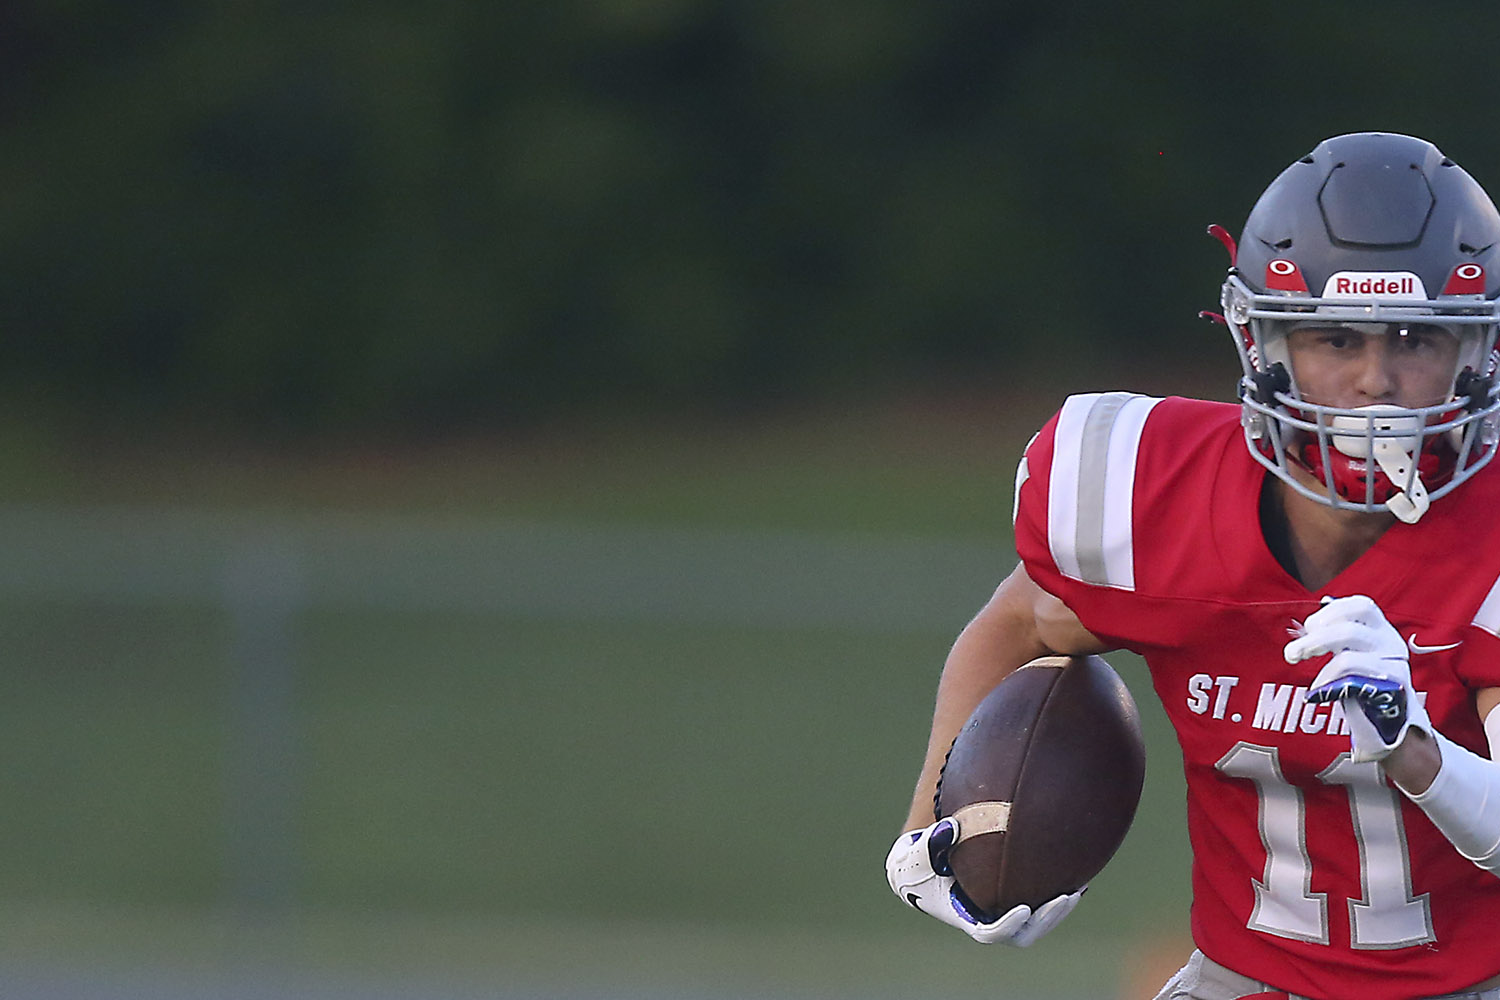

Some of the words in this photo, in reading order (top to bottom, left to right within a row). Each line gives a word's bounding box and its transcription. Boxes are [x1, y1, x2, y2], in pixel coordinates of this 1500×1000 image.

[1336, 277, 1414, 295] Riddell
[1186, 673, 1243, 723] ST.
[1252, 683, 1428, 736] MICH
[1214, 740, 1438, 951] 11
